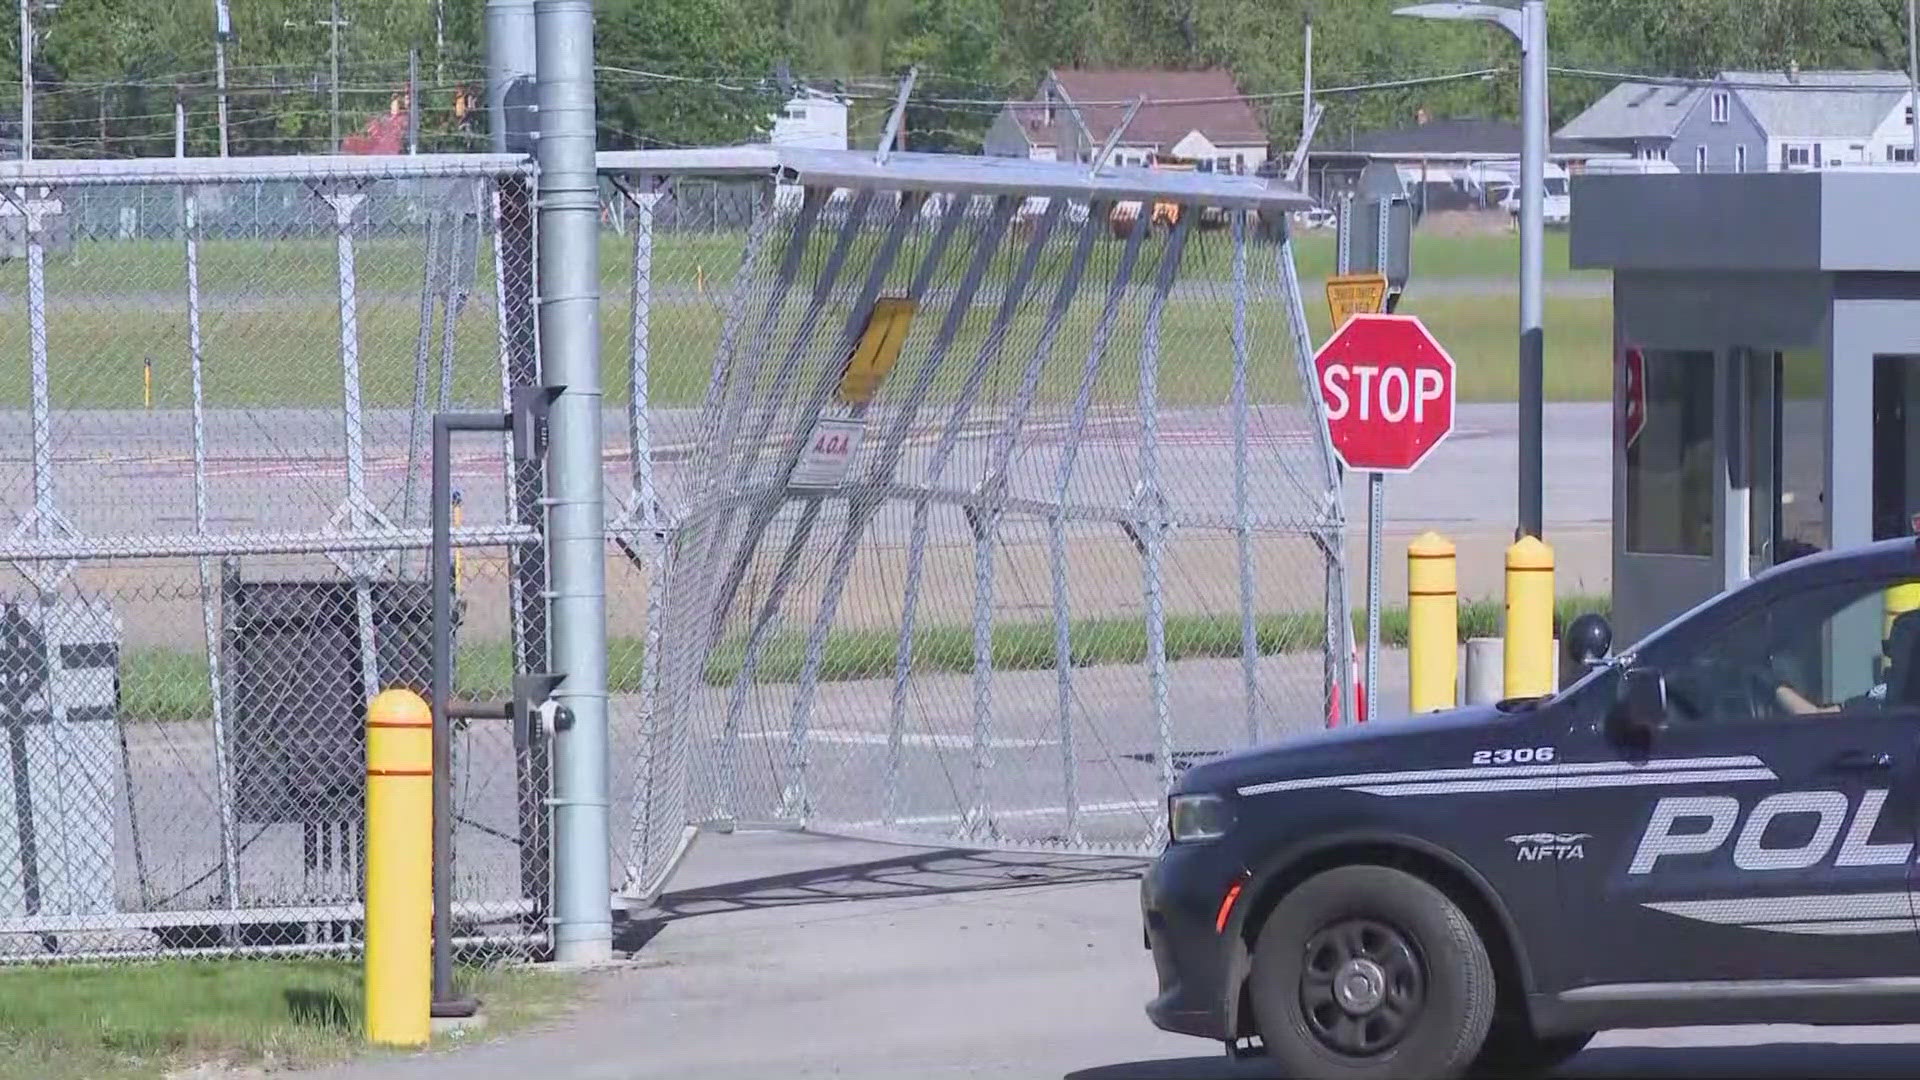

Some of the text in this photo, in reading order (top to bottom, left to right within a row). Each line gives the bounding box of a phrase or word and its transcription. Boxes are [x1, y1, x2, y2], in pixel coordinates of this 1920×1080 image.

[1324, 364, 1444, 423] STOP
[1472, 747, 1555, 764] 2306
[1627, 789, 1920, 874] POL
[1517, 845, 1584, 861] NFTA
